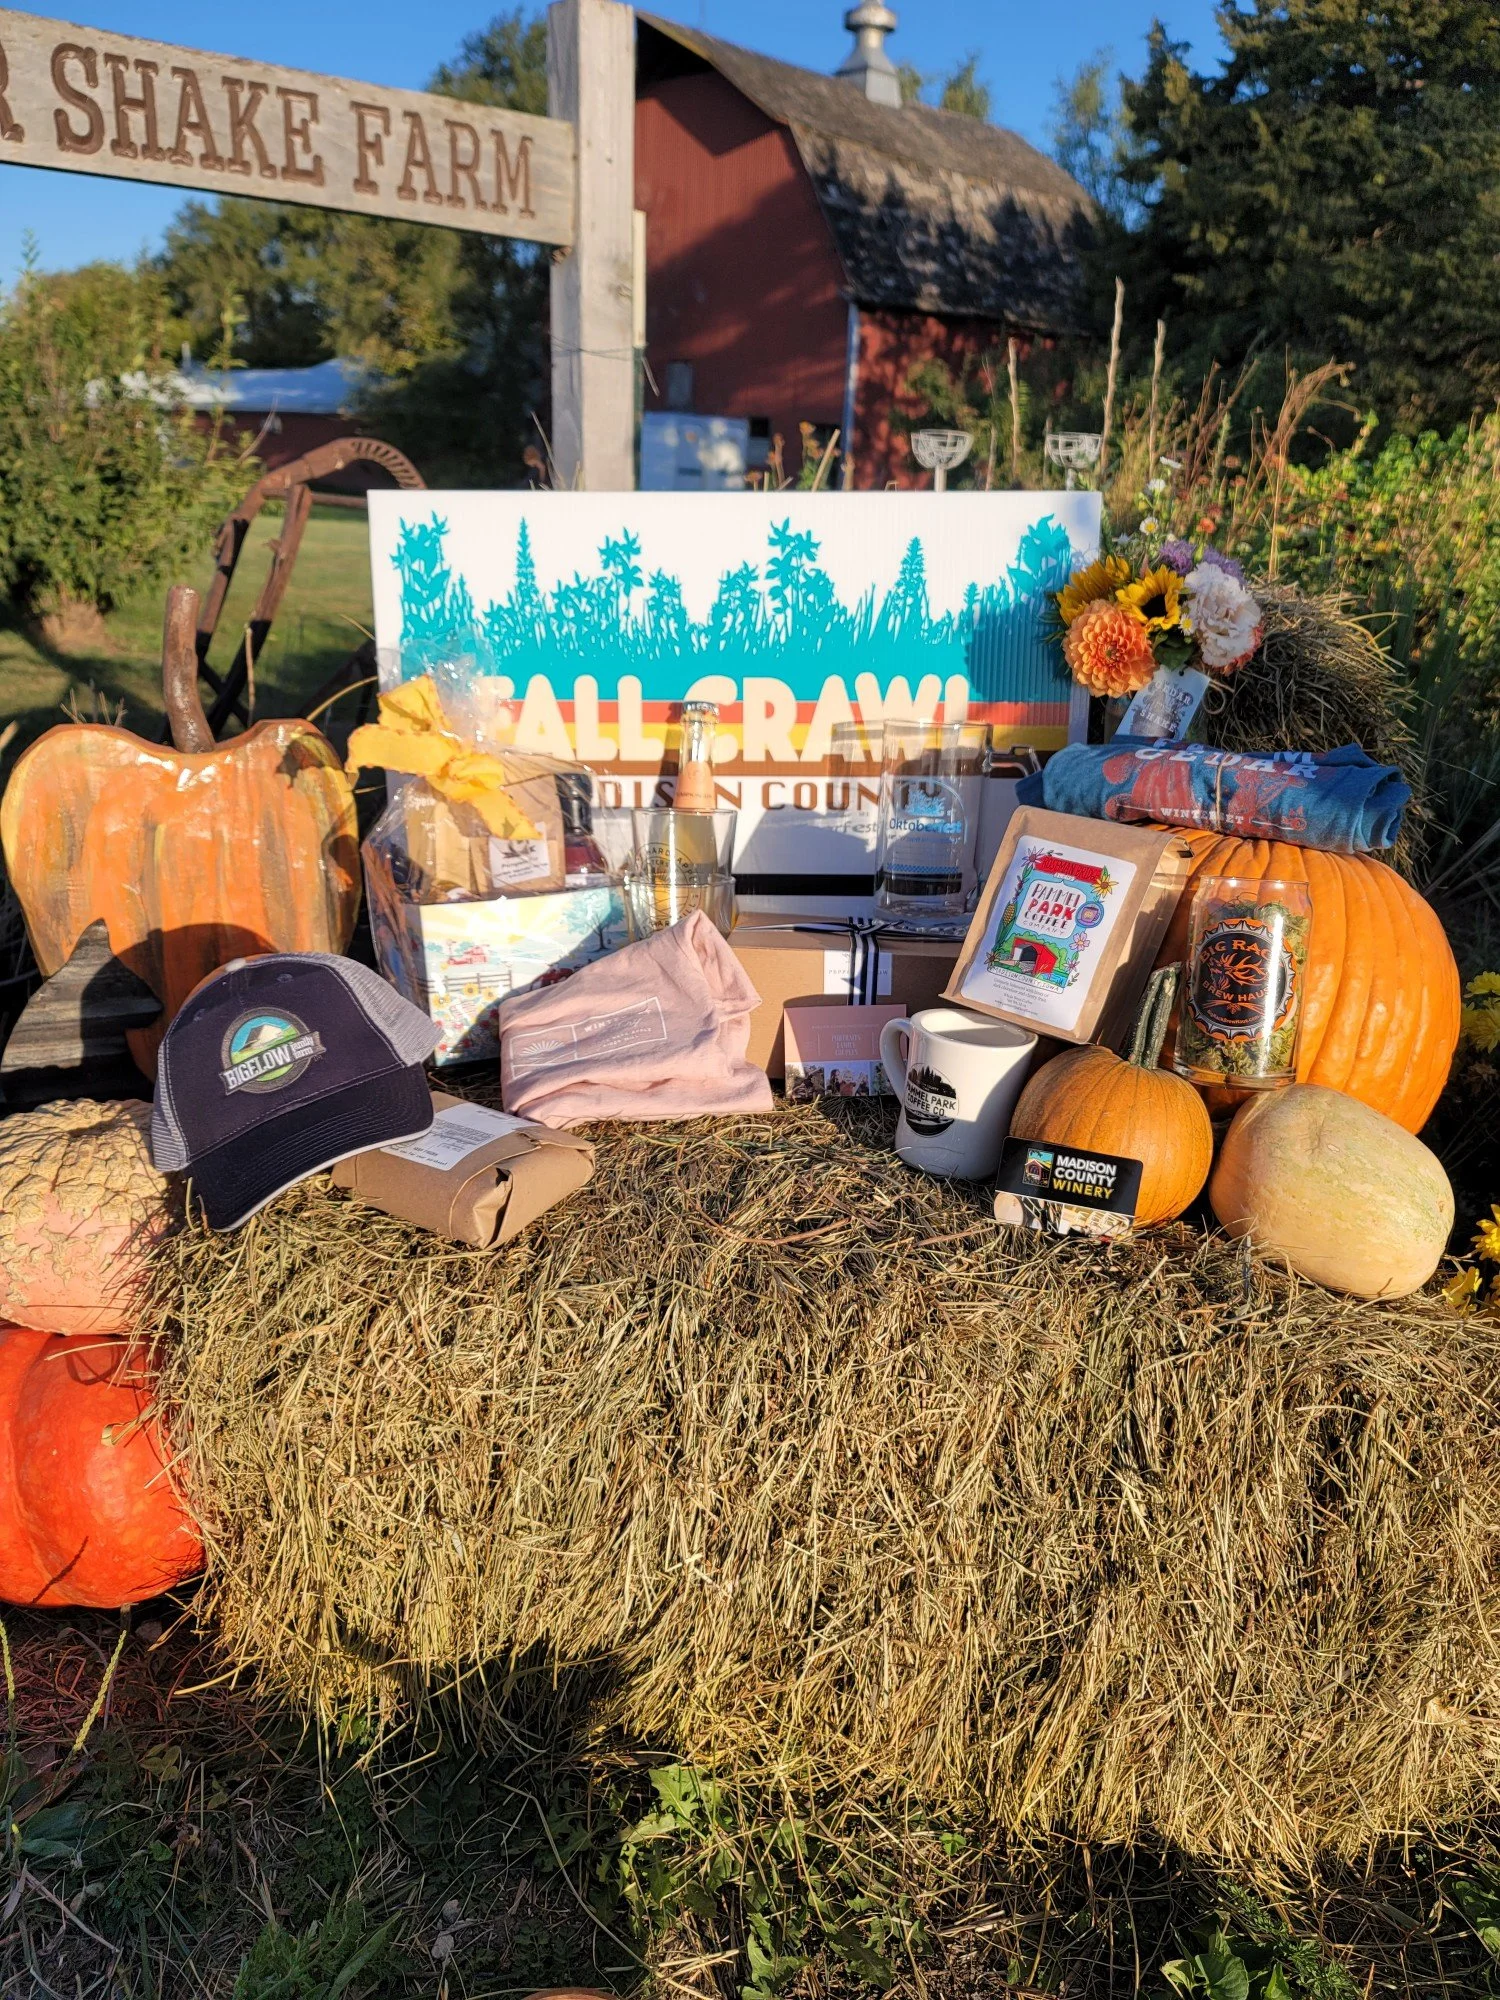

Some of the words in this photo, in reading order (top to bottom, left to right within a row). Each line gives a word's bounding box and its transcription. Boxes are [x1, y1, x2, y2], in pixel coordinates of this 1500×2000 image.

[50, 41, 325, 189] SHAKE
[350, 100, 537, 220] FARM
[1025, 910, 1067, 929] COFFEE
[1028, 898, 1076, 920] PARK
[1200, 941, 1227, 964] BIG
[1232, 939, 1271, 961] RAC
[1202, 980, 1234, 1001] BREW
[223, 1044, 291, 1091] BIGELOW
[931, 1096, 957, 1110] PARK
[1057, 1155, 1117, 1176] MADISON
[1054, 1167, 1116, 1187] COUNTY
[1053, 1178, 1114, 1199] WINERY
